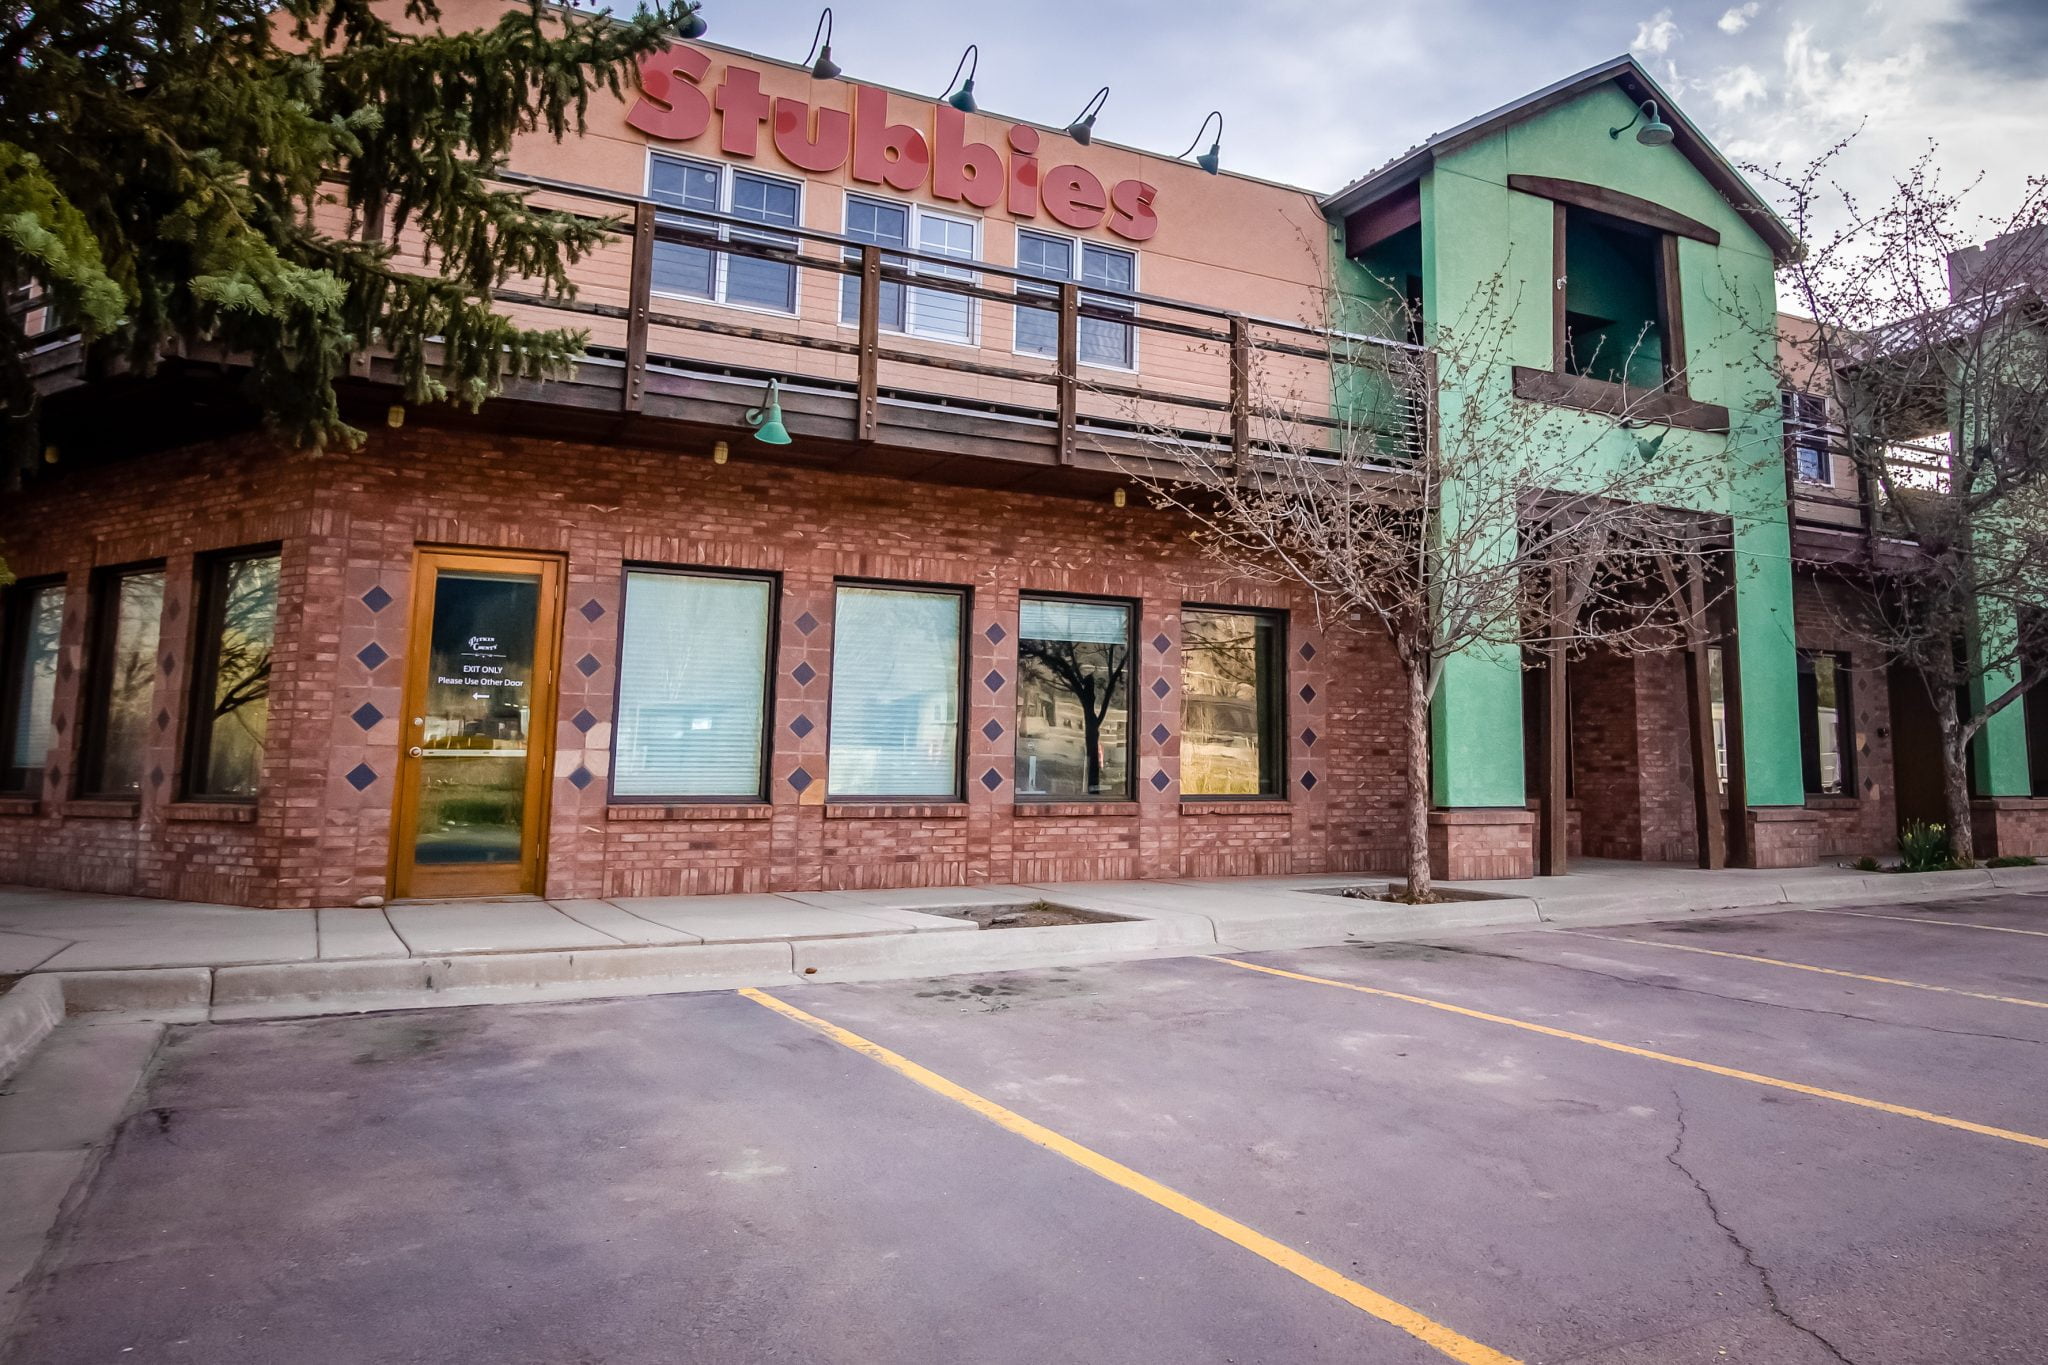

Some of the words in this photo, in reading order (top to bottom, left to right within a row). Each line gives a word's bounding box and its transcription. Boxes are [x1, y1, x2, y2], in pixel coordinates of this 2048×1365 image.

[625, 43, 1160, 241] Stubbies
[463, 665, 480, 673] EXIT
[481, 666, 503, 674] ONLY
[438, 676, 463, 685] Please
[464, 677, 479, 685] Use
[480, 678, 503, 687] Other
[504, 679, 524, 687] Door
